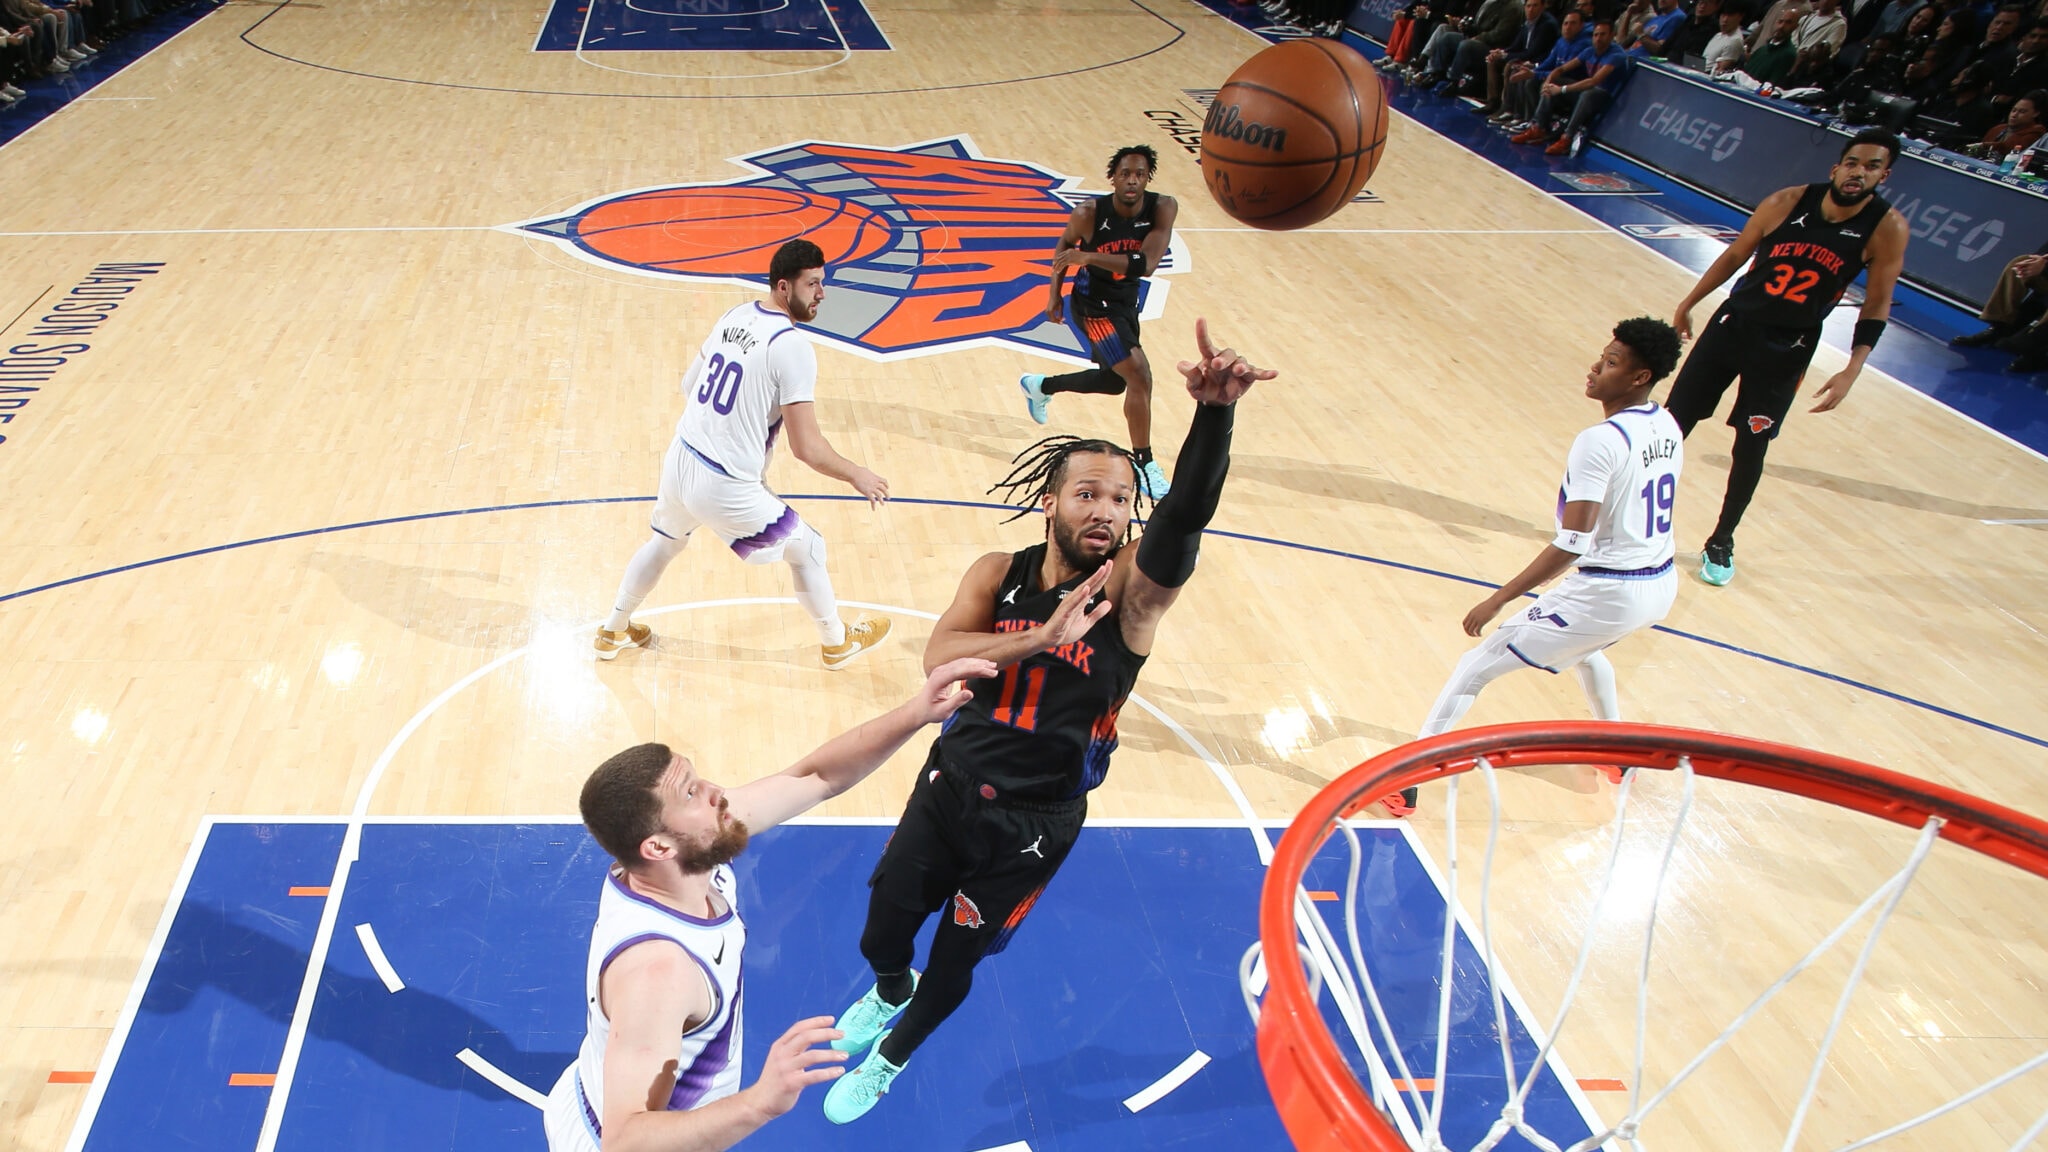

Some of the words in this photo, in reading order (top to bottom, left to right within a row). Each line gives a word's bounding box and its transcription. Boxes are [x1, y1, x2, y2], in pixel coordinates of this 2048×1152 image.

[1639, 102, 1722, 151] CHASE
[1951, 160, 1969, 170] CHASE
[1975, 168, 1994, 178] CHASE
[2001, 175, 2019, 185] CHASE
[2027, 183, 2047, 194] CHASE
[1875, 185, 1973, 248] ASE
[1122, 239, 1143, 251] YOR
[1769, 242, 1810, 258] NEW
[1807, 243, 1845, 275] YORK
[26, 262, 167, 336] MADISON
[1764, 263, 1820, 304] 32
[0, 343, 91, 423] SQUA
[697, 352, 744, 416] 30
[1642, 438, 1677, 468] BAILEY
[1641, 472, 1676, 539] 19
[990, 661, 1049, 734] 11
